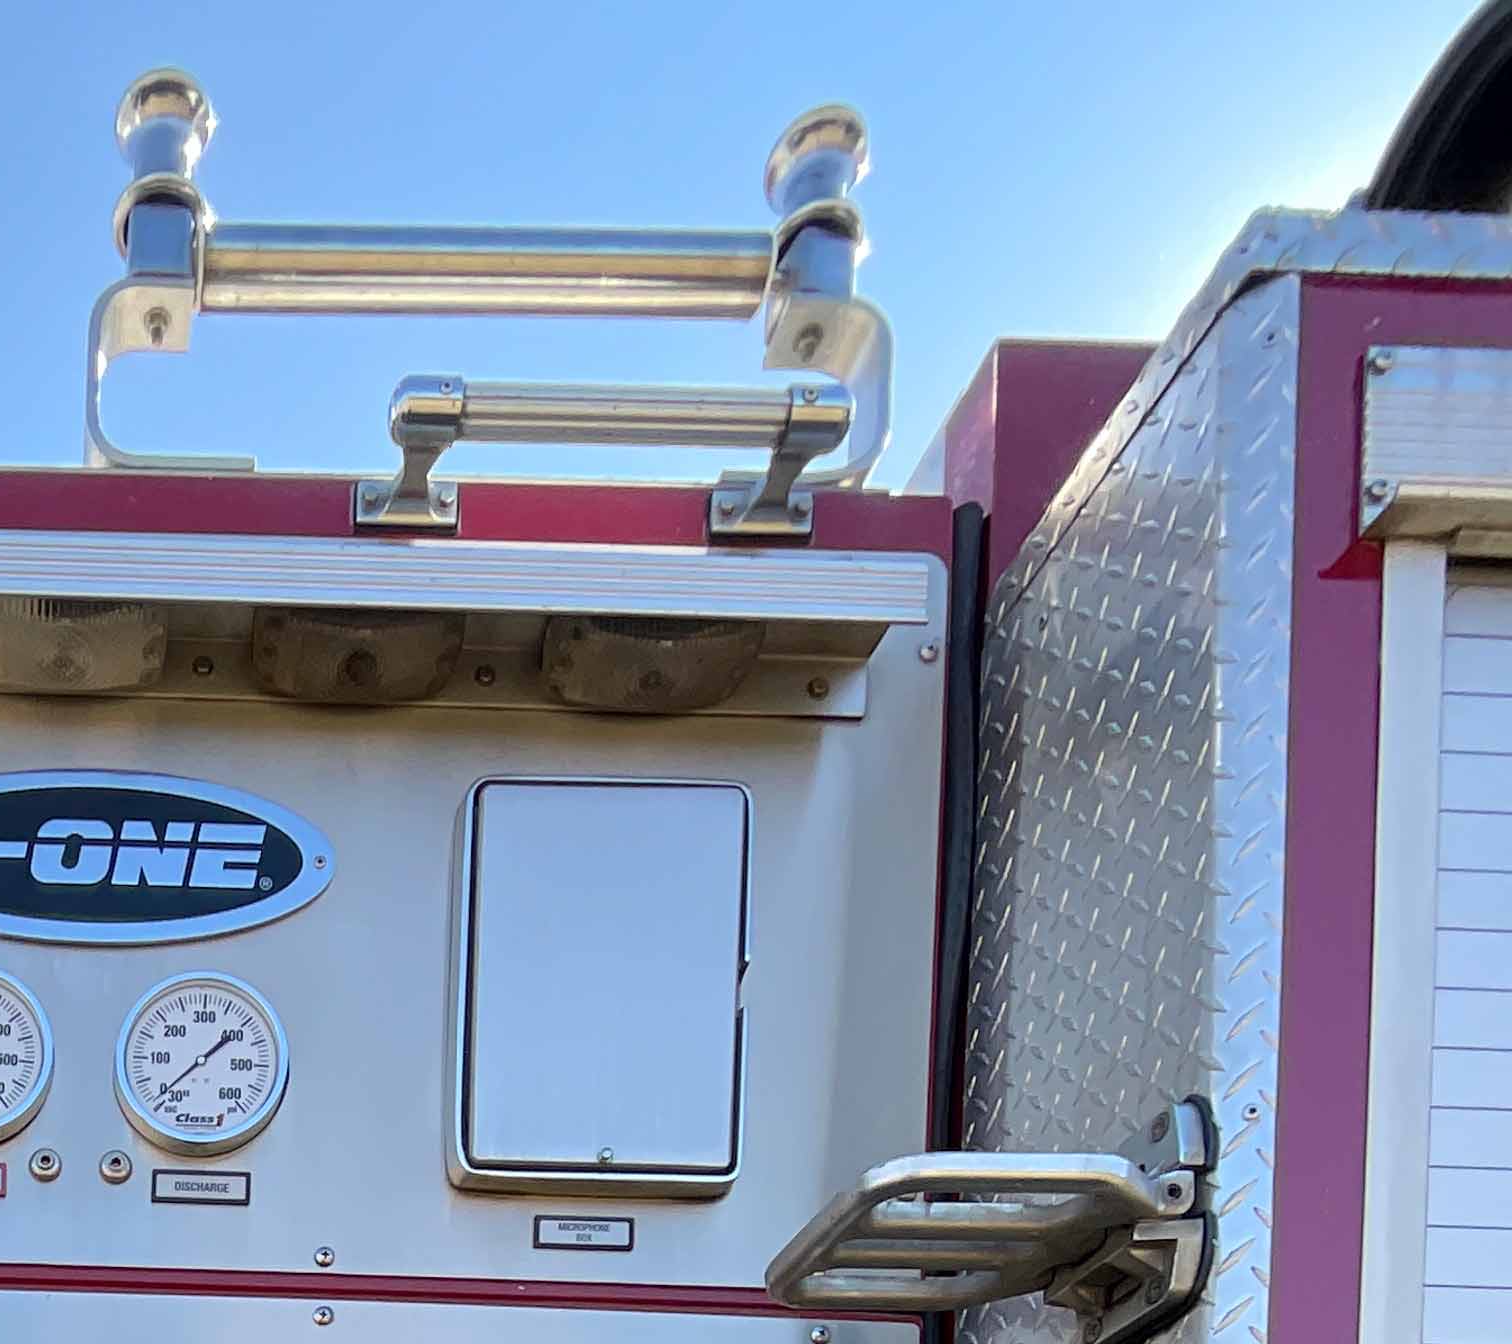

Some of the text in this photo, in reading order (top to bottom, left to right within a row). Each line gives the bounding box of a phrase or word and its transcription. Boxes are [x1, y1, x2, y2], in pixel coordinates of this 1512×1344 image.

[193, 1010, 216, 1023] 300
[164, 1025, 186, 1037] 200
[221, 1029, 243, 1041] 400
[151, 1052, 170, 1064] 100
[230, 1059, 253, 1071] 500
[219, 1088, 241, 1100] 600
[174, 1181, 230, 1194] DISCHARGE
